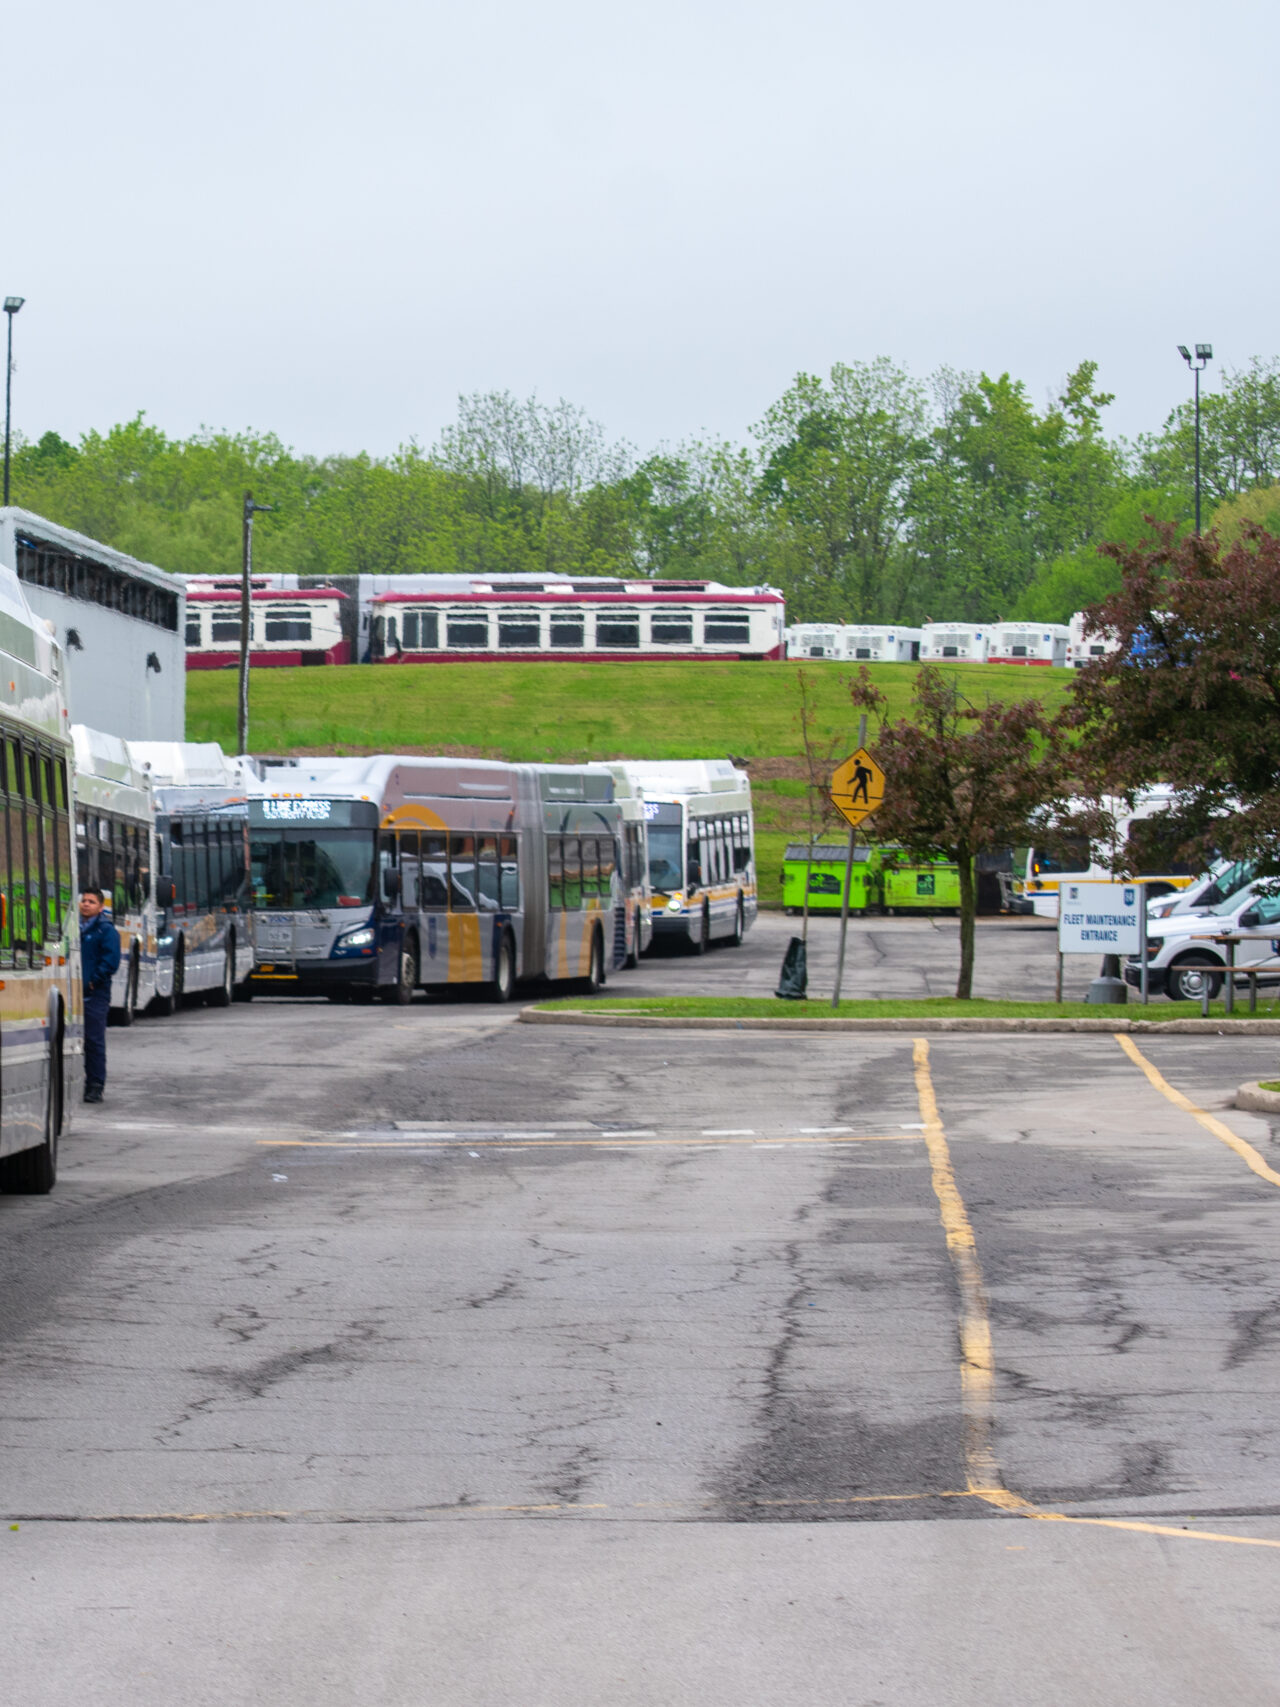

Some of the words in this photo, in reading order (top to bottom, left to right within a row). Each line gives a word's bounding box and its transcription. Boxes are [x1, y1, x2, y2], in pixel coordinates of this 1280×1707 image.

[1064, 913, 1084, 925] FLEET
[1086, 914, 1136, 926] MAINTENANCE
[1081, 929, 1118, 941] ENTRANCE
